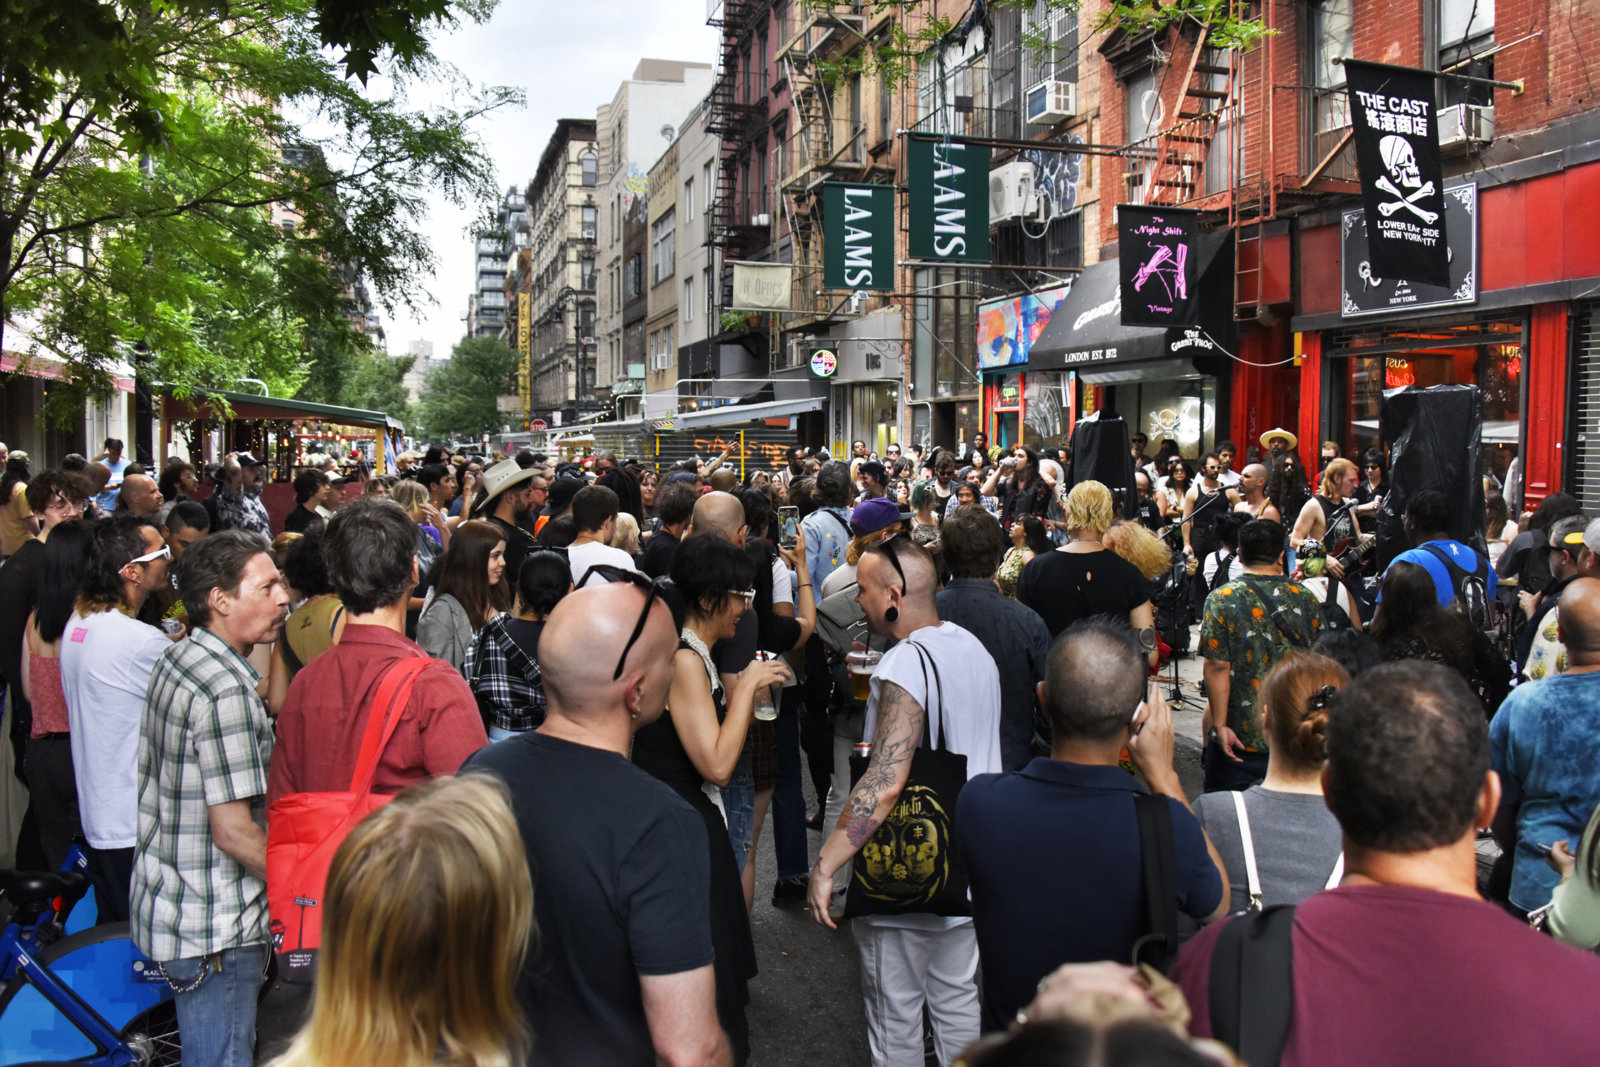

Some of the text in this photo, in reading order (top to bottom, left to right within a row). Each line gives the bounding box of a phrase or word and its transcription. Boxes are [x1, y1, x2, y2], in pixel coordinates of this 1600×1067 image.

[1356, 90, 1429, 116] THE CAST
[933, 142, 966, 257] LAAMS
[1134, 225, 1183, 236] Night Shift
[1377, 220, 1407, 231] LOWER
[1422, 228, 1440, 238] SIDE
[844, 187, 873, 287] LAAMS
[1383, 230, 1402, 240] NEW
[1403, 231, 1422, 243] YORK
[1389, 295, 1417, 305] NEW YORK
[1147, 304, 1173, 314] Vintage
[1184, 329, 1199, 339] THE
[1064, 351, 1090, 363] LONDON
[530, 424, 547, 432] STOP
